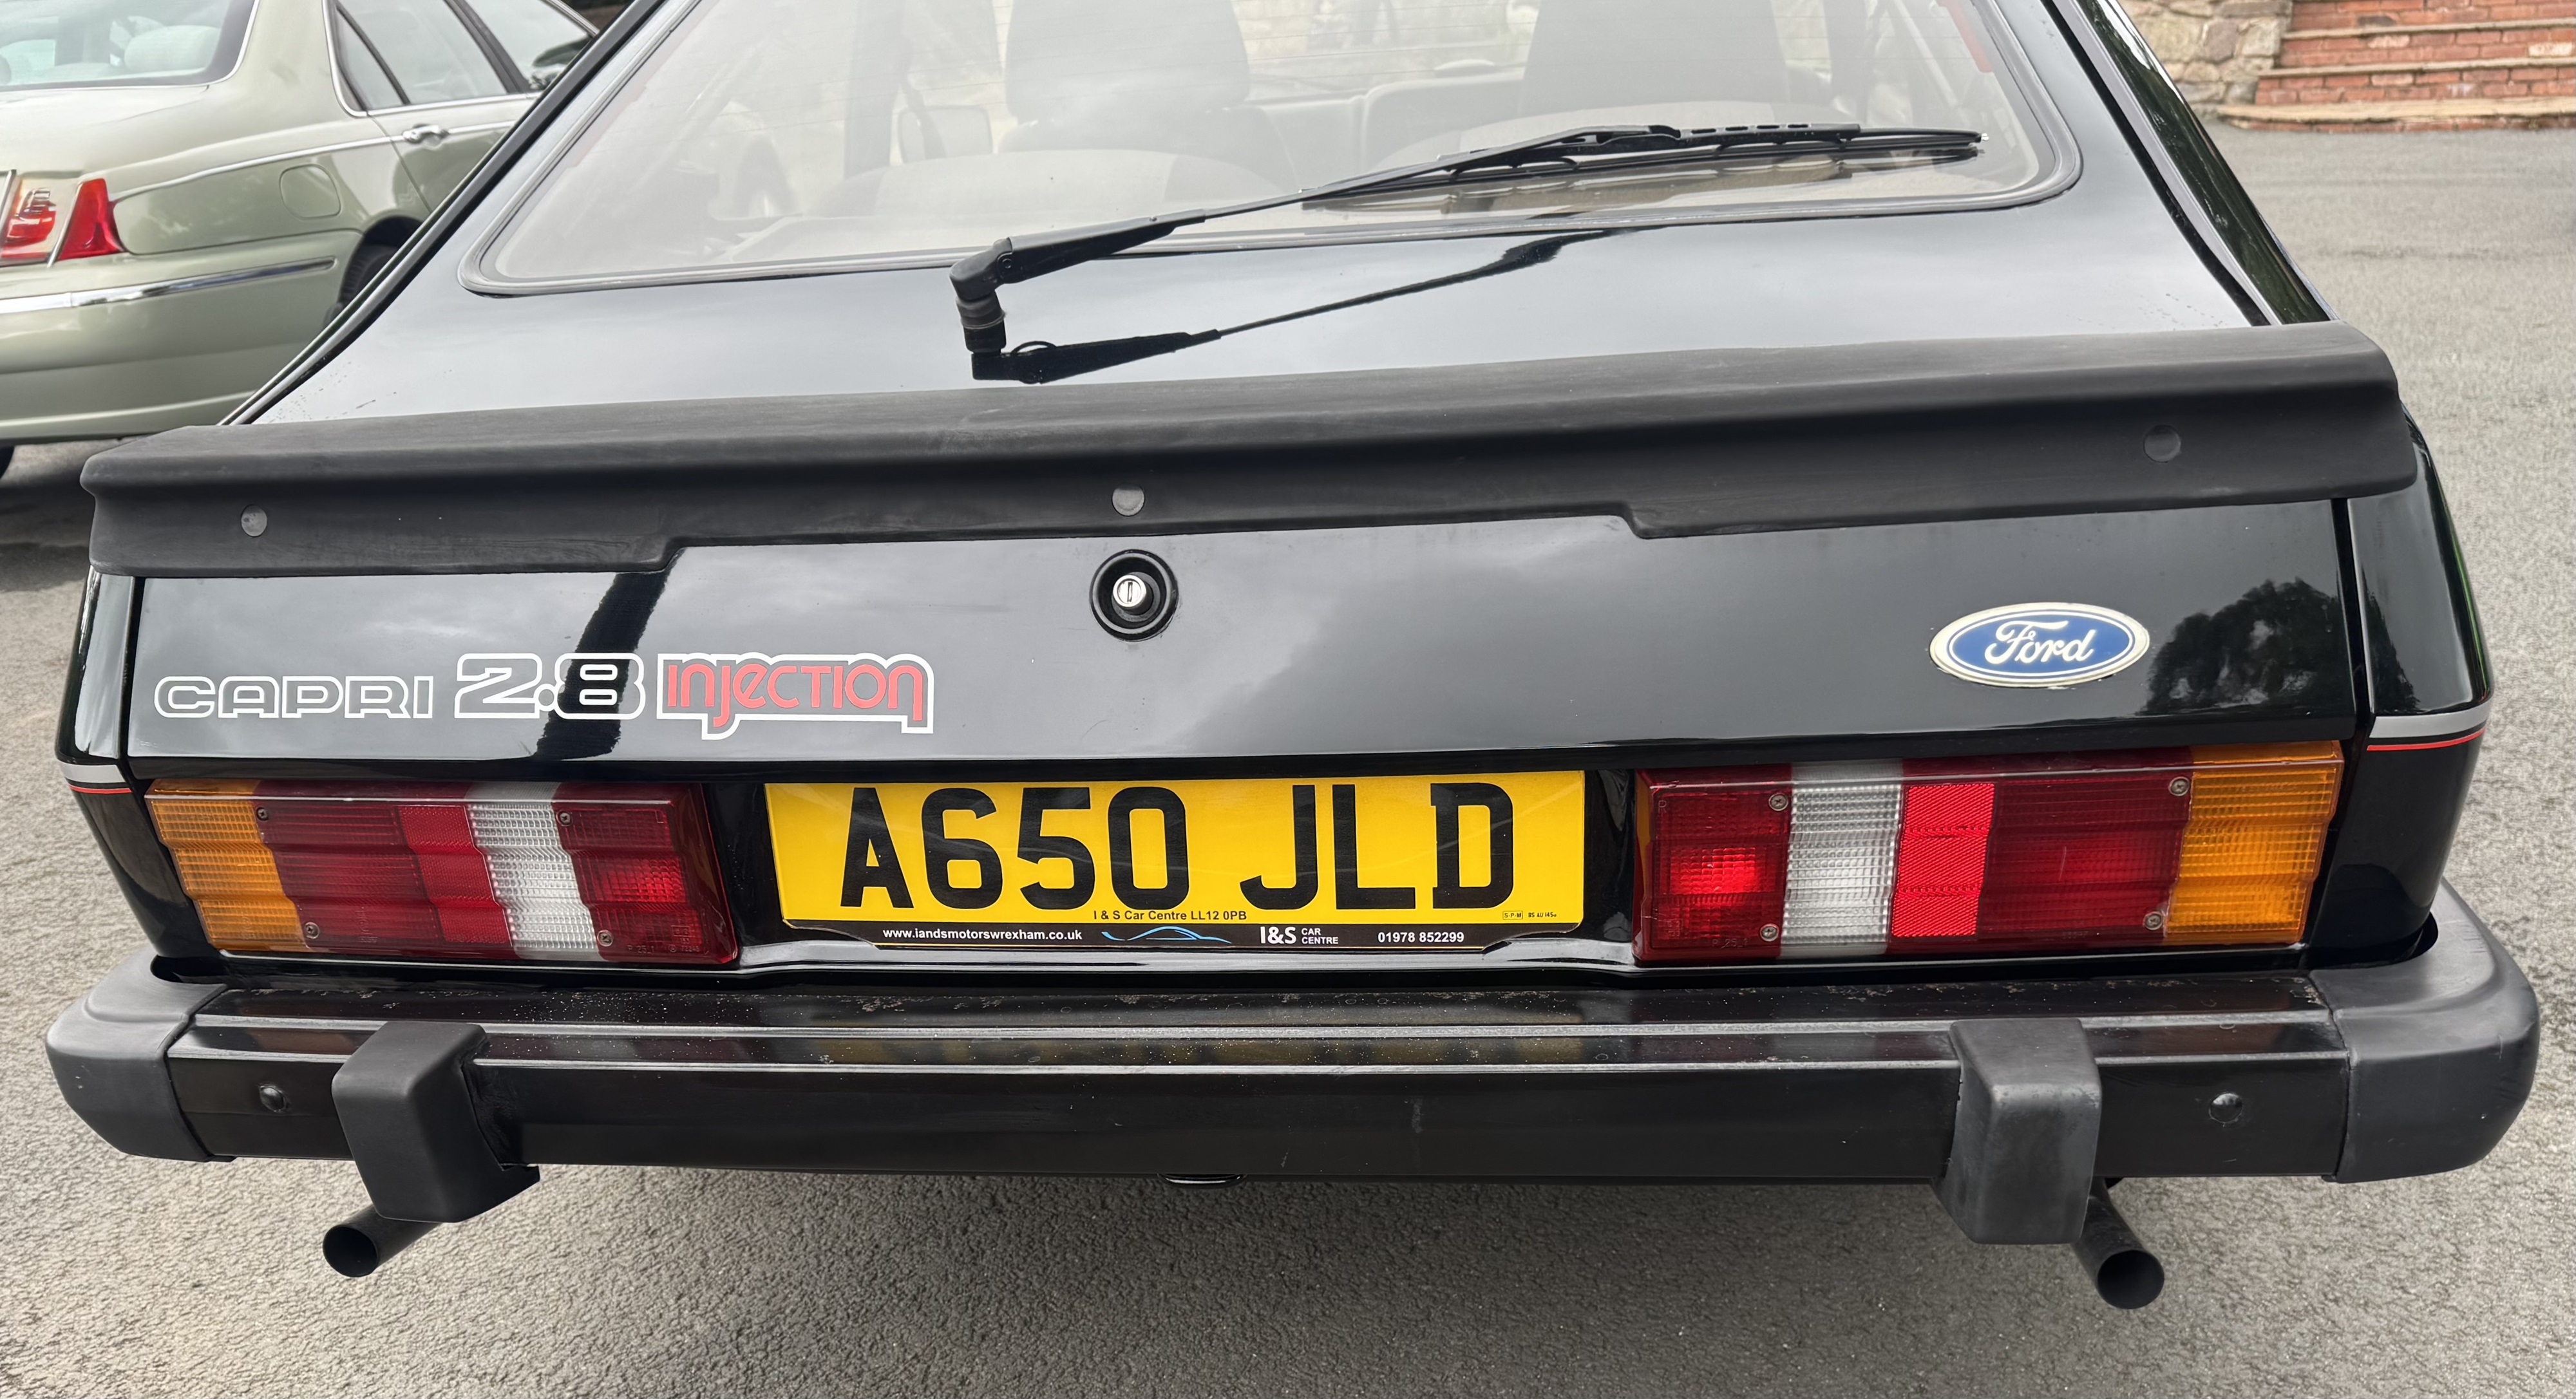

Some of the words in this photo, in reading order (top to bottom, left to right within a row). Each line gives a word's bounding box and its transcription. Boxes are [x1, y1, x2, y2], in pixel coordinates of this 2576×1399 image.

[1984, 619, 2096, 666] Ford
[153, 675, 434, 718] CAPRI
[454, 652, 645, 720] 2.8
[840, 786, 1189, 910] A650
[1240, 782, 1513, 910] JLD
[1101, 910, 1110, 920] &
[1113, 910, 1121, 920] S
[1124, 910, 1144, 920] Car
[1148, 910, 1187, 921] Centre
[1191, 910, 1220, 920] LL12
[883, 928, 1083, 940] www.iandsmotorswrexham.co.uk
[1260, 926, 1297, 944] I&S
[1302, 936, 1339, 944] CENTRE
[1378, 932, 1416, 943] 01978
[1419, 932, 1464, 943] 852299
